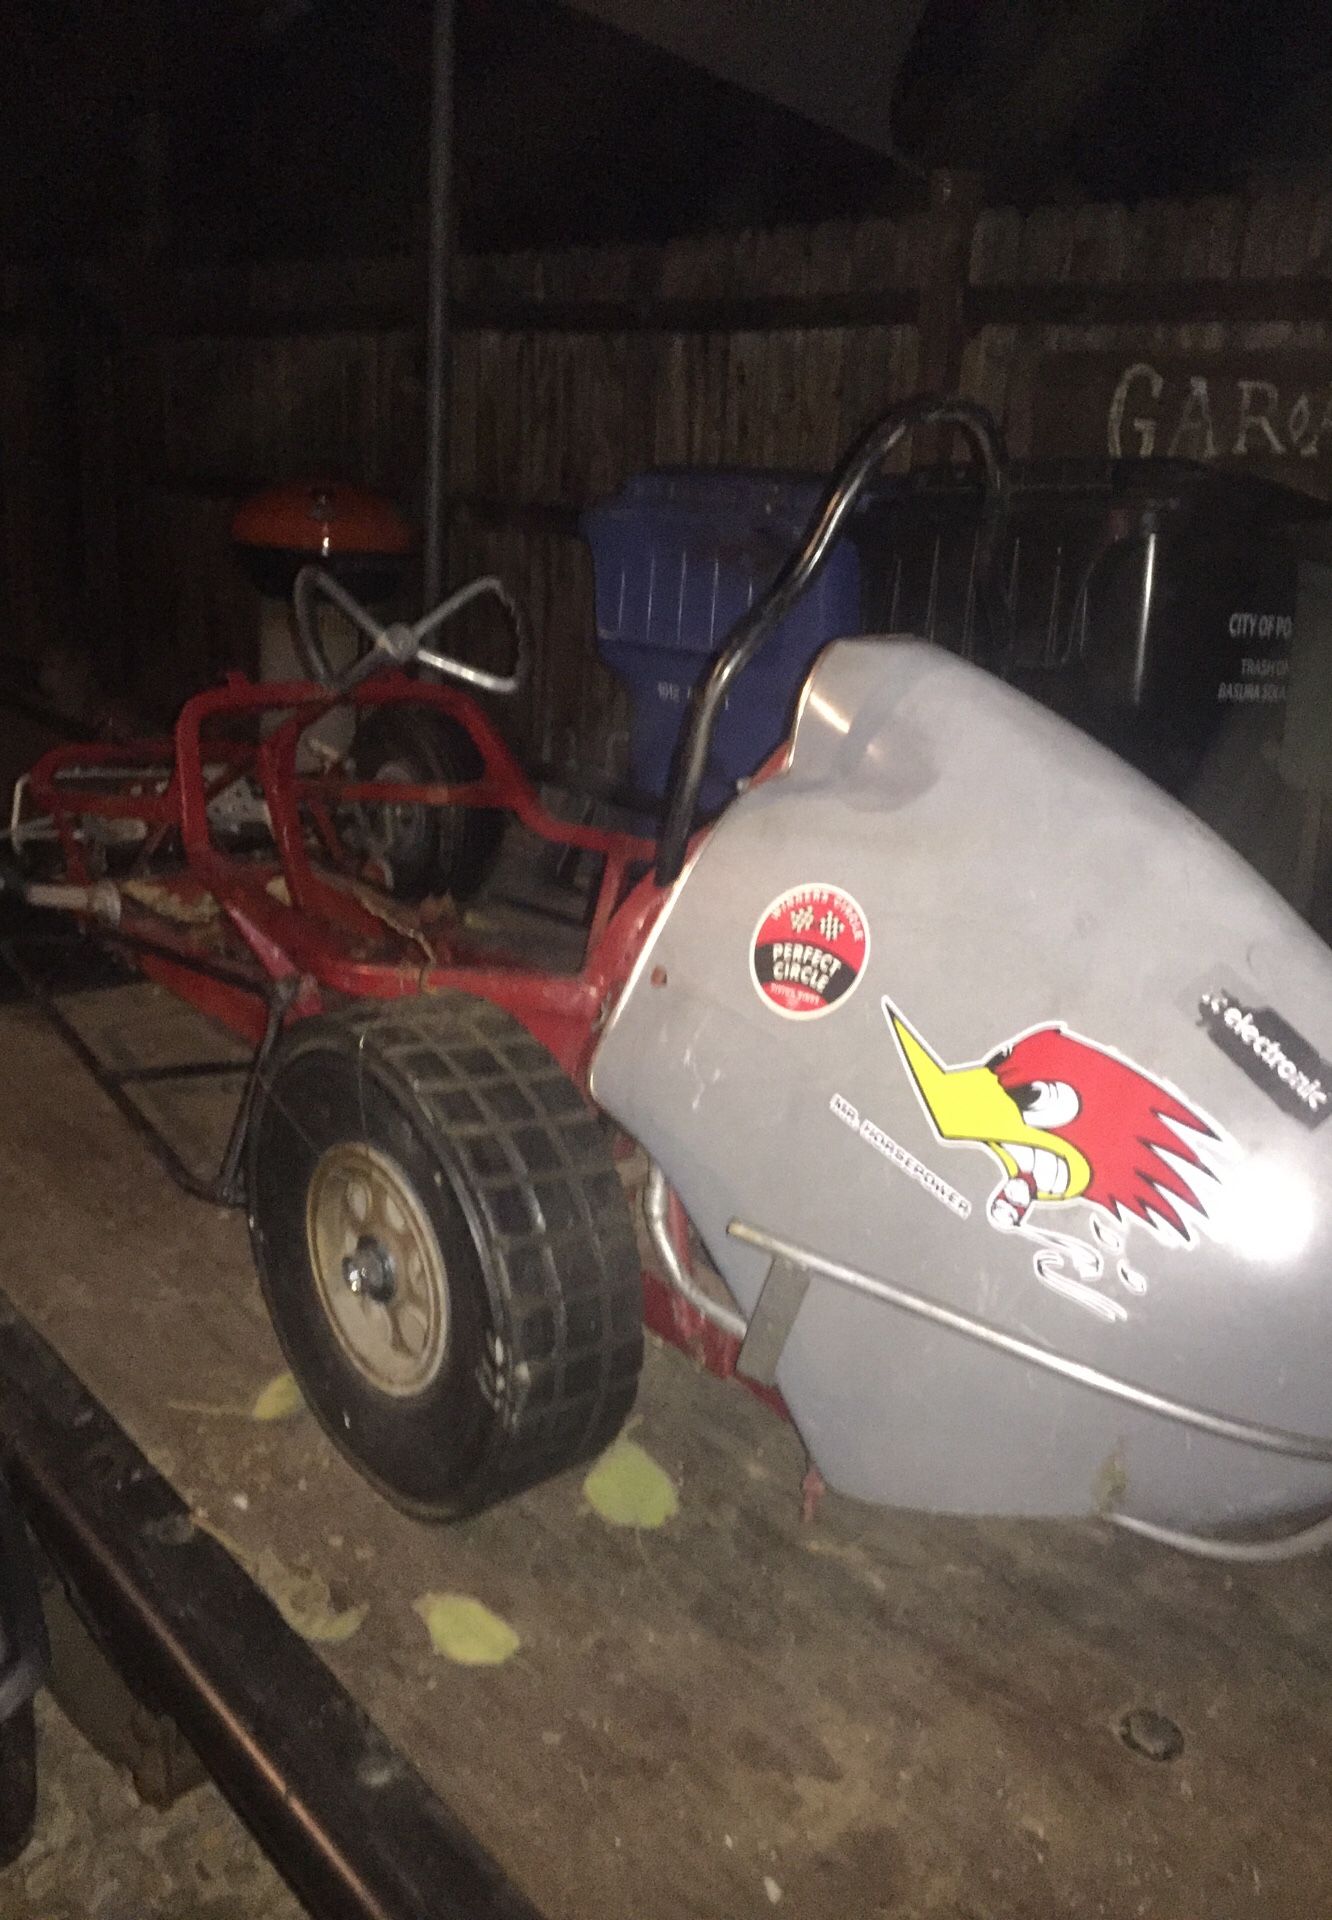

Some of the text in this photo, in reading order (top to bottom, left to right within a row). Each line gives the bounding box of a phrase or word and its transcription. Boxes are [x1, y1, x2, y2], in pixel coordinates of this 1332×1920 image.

[1229, 611, 1258, 638] CITY
[772, 942, 842, 978] PERFECT
[773, 960, 830, 994] CIRCLE
[860, 1119, 972, 1220] HORSEPOWER
